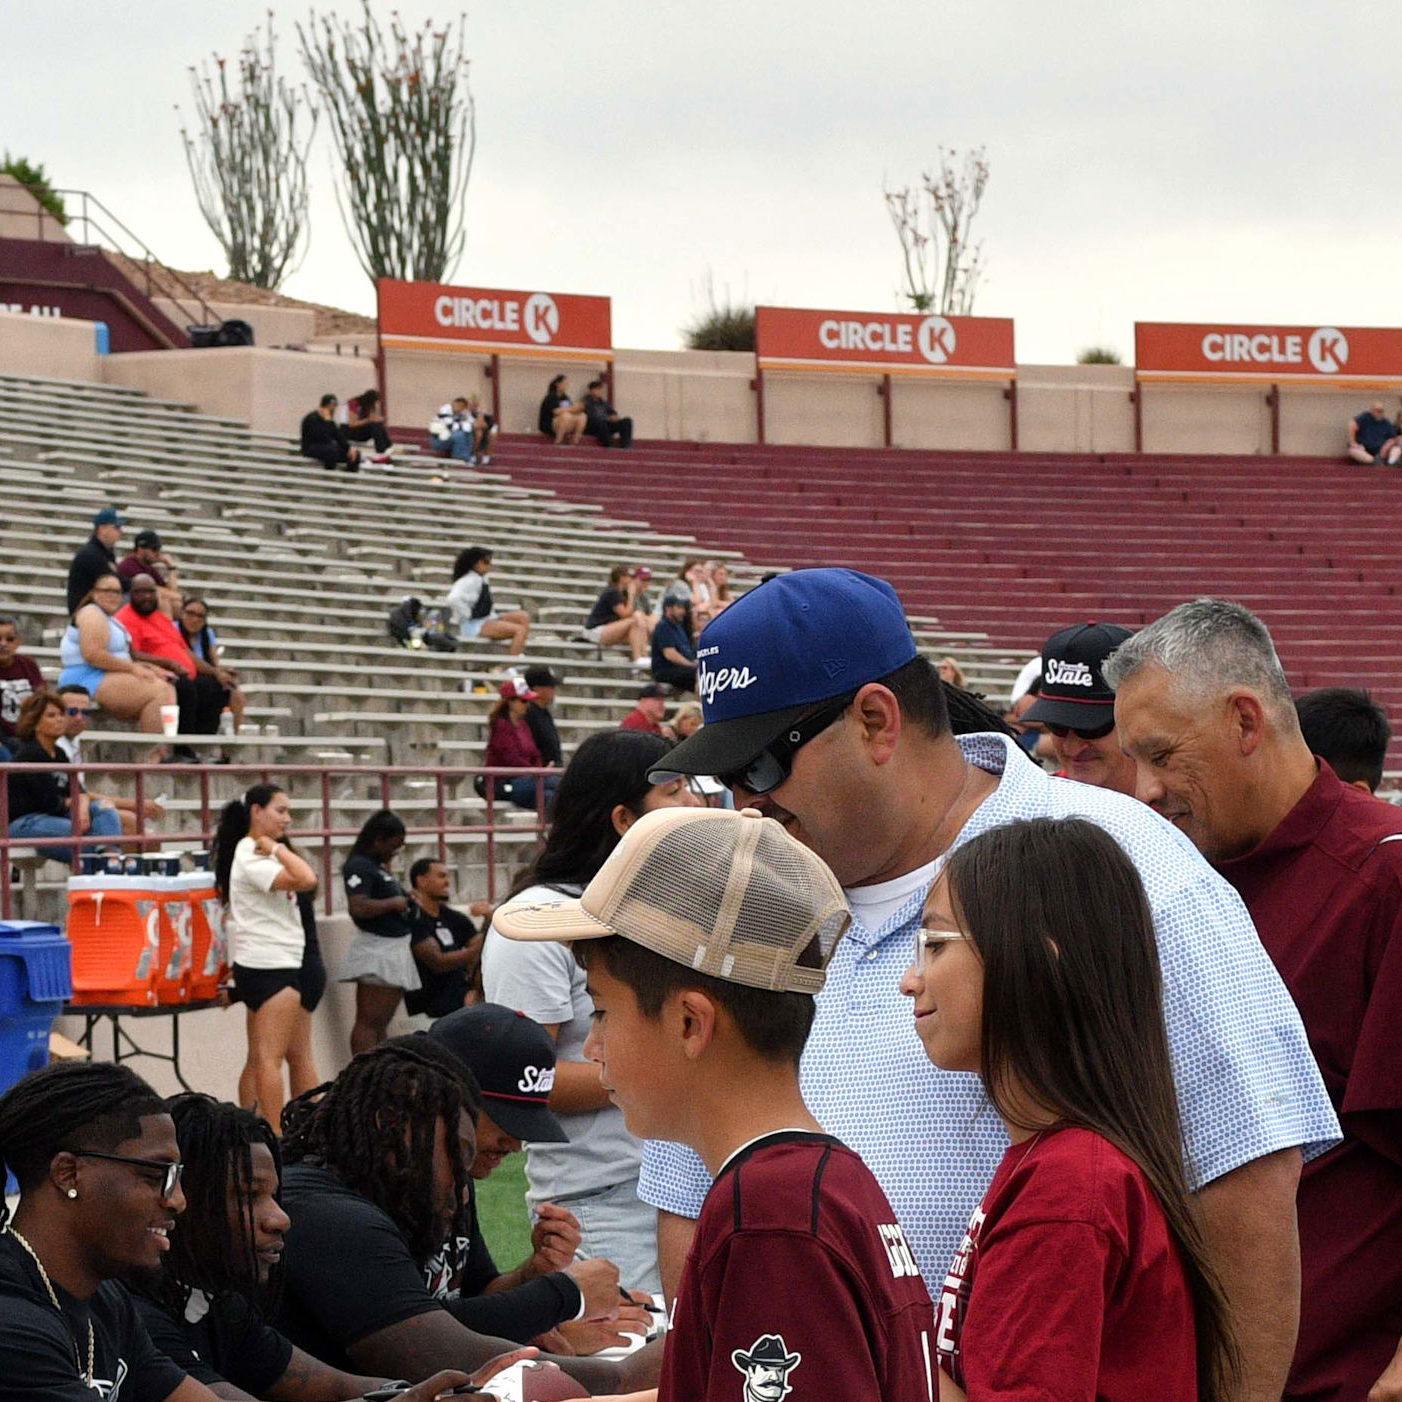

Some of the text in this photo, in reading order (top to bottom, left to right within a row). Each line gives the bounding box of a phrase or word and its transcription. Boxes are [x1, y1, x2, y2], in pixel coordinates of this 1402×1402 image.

[434, 295, 556, 342] CIRCLE K
[819, 320, 953, 361] CIRCLE K
[1201, 331, 1346, 371] CIRCLE K
[1045, 658, 1094, 687] State
